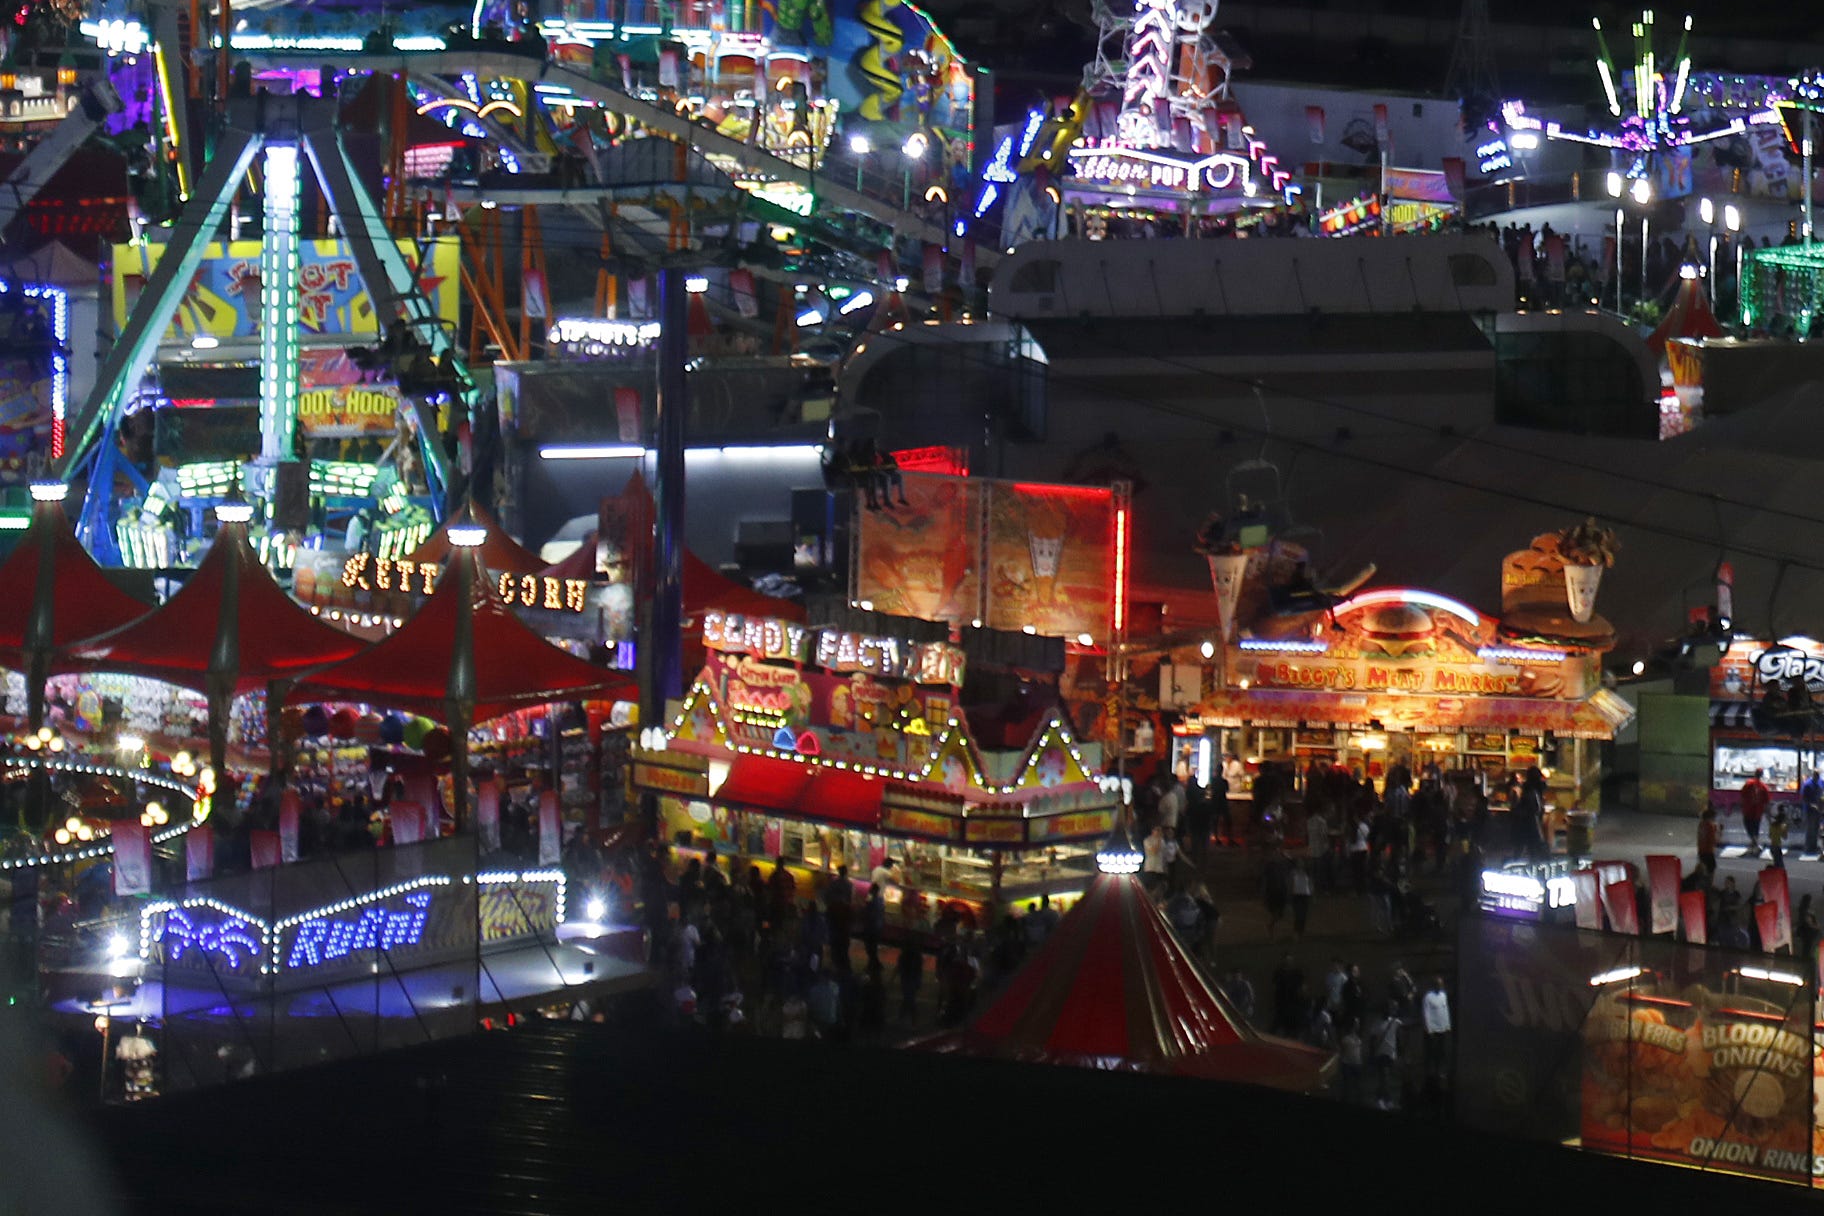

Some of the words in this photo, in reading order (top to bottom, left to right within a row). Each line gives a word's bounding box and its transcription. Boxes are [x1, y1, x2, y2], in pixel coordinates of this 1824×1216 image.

[1151, 164, 1185, 187] POP
[346, 390, 398, 416] HOOP
[341, 551, 439, 595] KETT
[499, 571, 588, 613] CORN
[703, 612, 804, 657] CANDY
[1713, 1047, 1807, 1079] ONIONS
[1690, 1137, 1758, 1164] ONION
